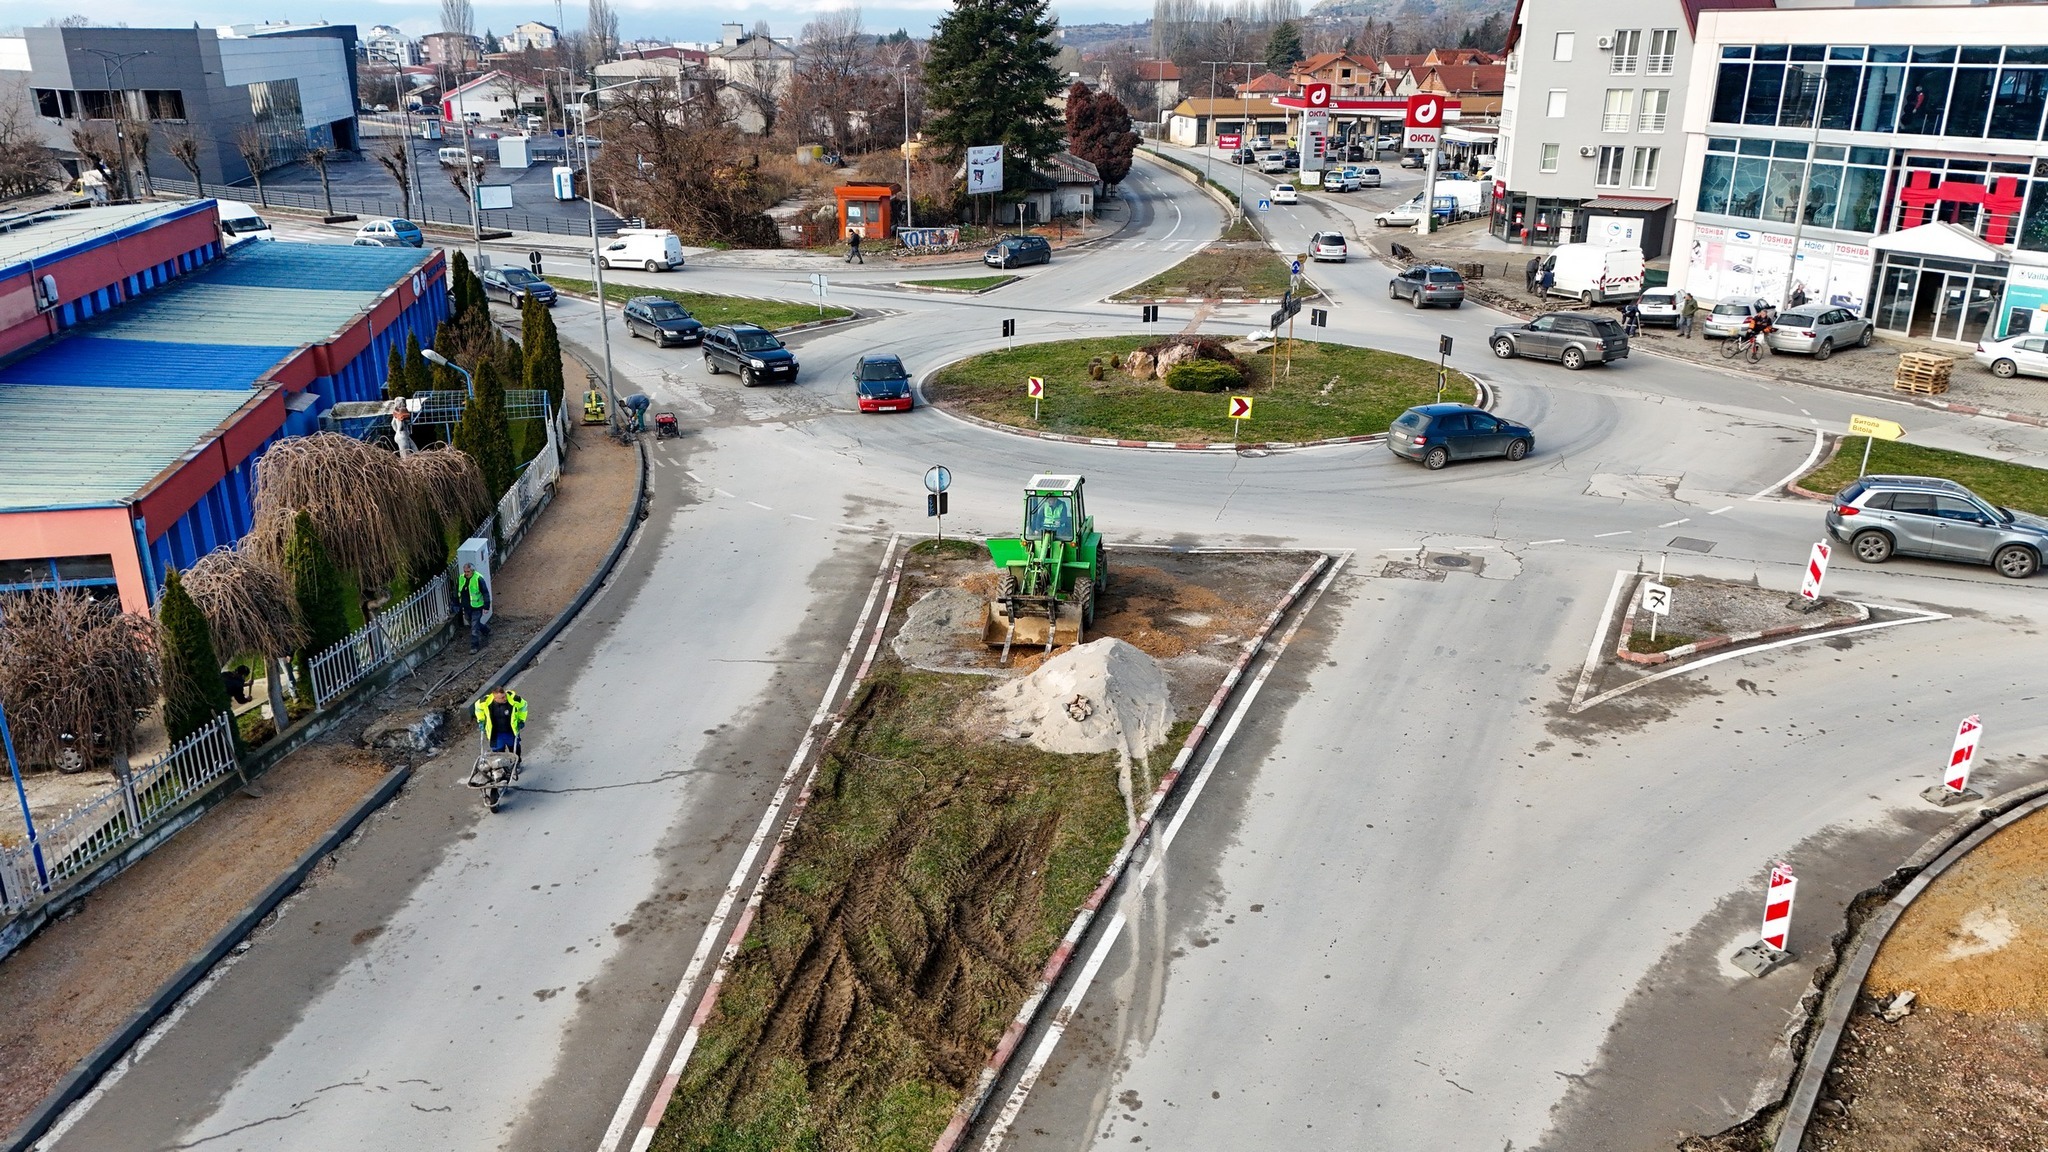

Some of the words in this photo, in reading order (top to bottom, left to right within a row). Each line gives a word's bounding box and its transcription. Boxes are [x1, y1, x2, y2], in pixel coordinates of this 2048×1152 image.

[1308, 110, 1327, 118] OKTA
[1409, 133, 1436, 142] OKTA
[1696, 226, 1724, 236] TOSHIBA
[1763, 234, 1793, 246] TOSHIBA
[1804, 240, 1825, 250] Haier
[1836, 245, 1870, 257] TOSHIBA
[1854, 417, 1880, 428] Битола
[1852, 424, 1873, 434] Bitola
